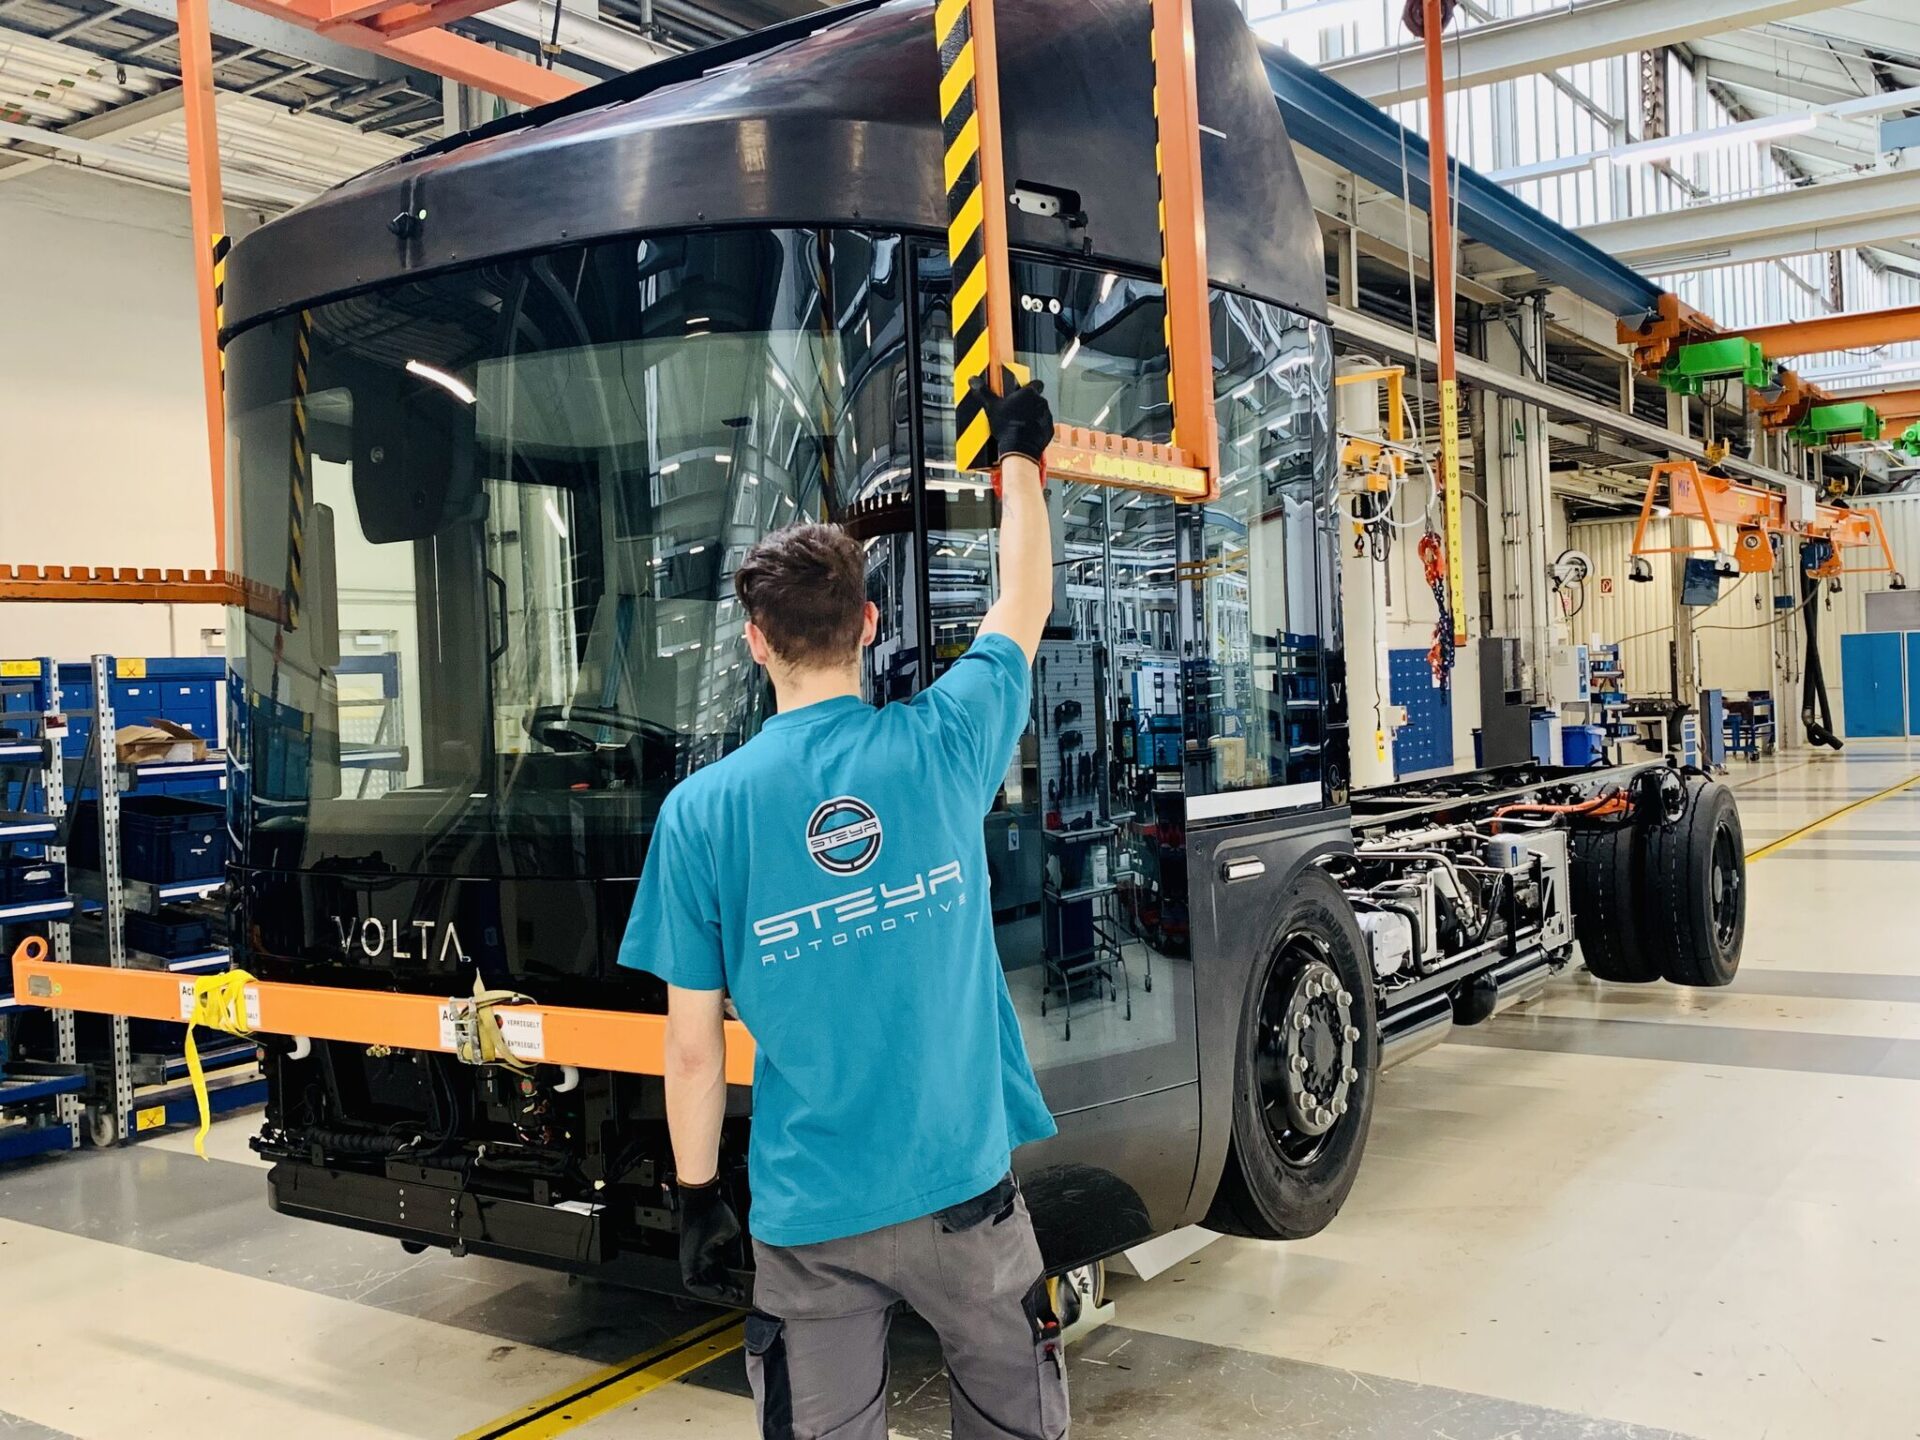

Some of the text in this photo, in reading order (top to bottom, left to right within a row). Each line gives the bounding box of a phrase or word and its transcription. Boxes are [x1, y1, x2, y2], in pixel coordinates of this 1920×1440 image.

[810, 821, 878, 849] STEYR
[753, 860, 964, 946] STEYR
[330, 915, 472, 963] VOLTA
[761, 893, 967, 967] AUTOMOTIVE
[507, 1019, 540, 1029] VERRIEGELT
